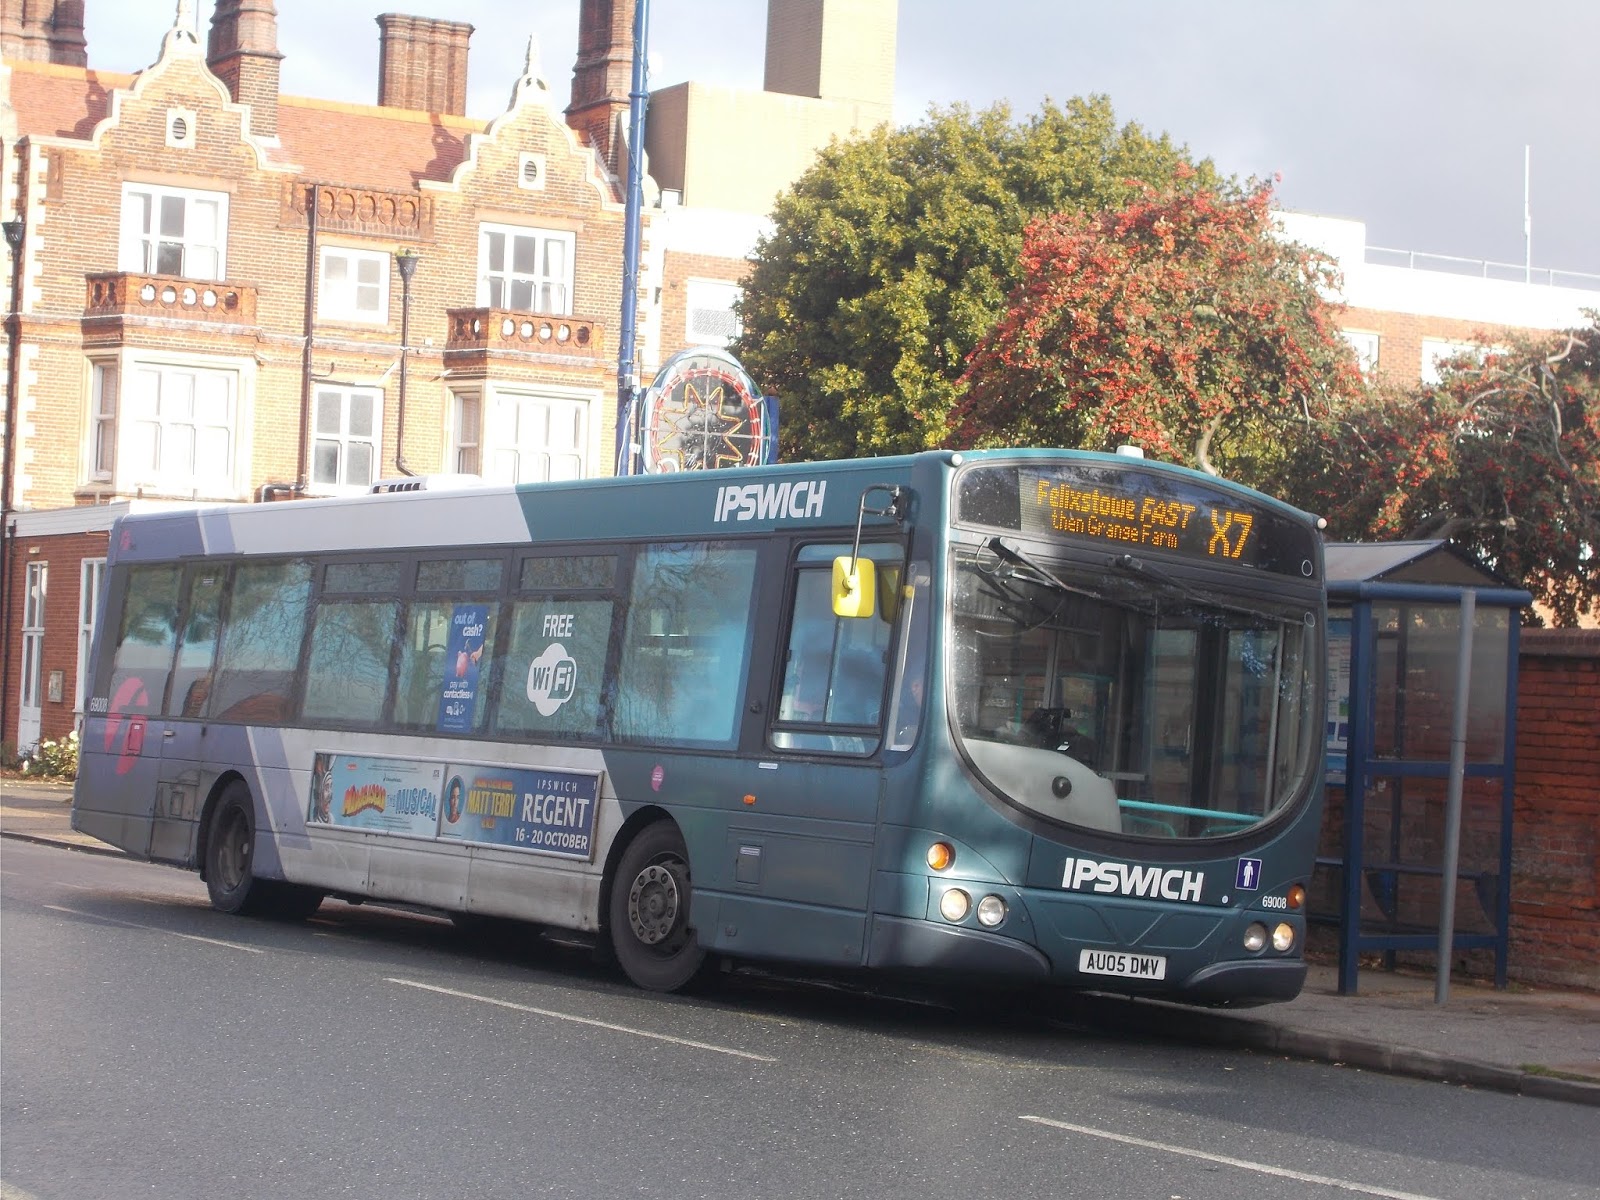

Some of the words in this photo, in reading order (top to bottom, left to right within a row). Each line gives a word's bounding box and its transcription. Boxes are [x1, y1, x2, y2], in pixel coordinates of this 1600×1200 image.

[714, 480, 827, 522] IPSWICH
[1037, 479, 1136, 521] Felixstowe
[1140, 497, 1196, 529] FAST
[1052, 510, 1085, 534] then
[1087, 515, 1139, 543] Grange
[1141, 524, 1178, 549] Farm
[1208, 508, 1253, 559] X7
[454, 613, 467, 625] out
[467, 612, 476, 625] of
[462, 624, 483, 637] cash?
[542, 614, 574, 638] FREE
[537, 779, 577, 793] IPSWICH
[395, 787, 437, 821] MUSICAL
[466, 790, 491, 815] MATT
[491, 792, 517, 818] TERRY
[521, 793, 590, 828] REGENT
[515, 827, 525, 842] 16
[531, 829, 544, 845] 20
[544, 831, 588, 850] OCTOBER
[1061, 857, 1204, 902] IPSWICH
[1262, 895, 1287, 909] 69008
[1086, 952, 1126, 973] AU05
[1130, 956, 1159, 976] DMV
